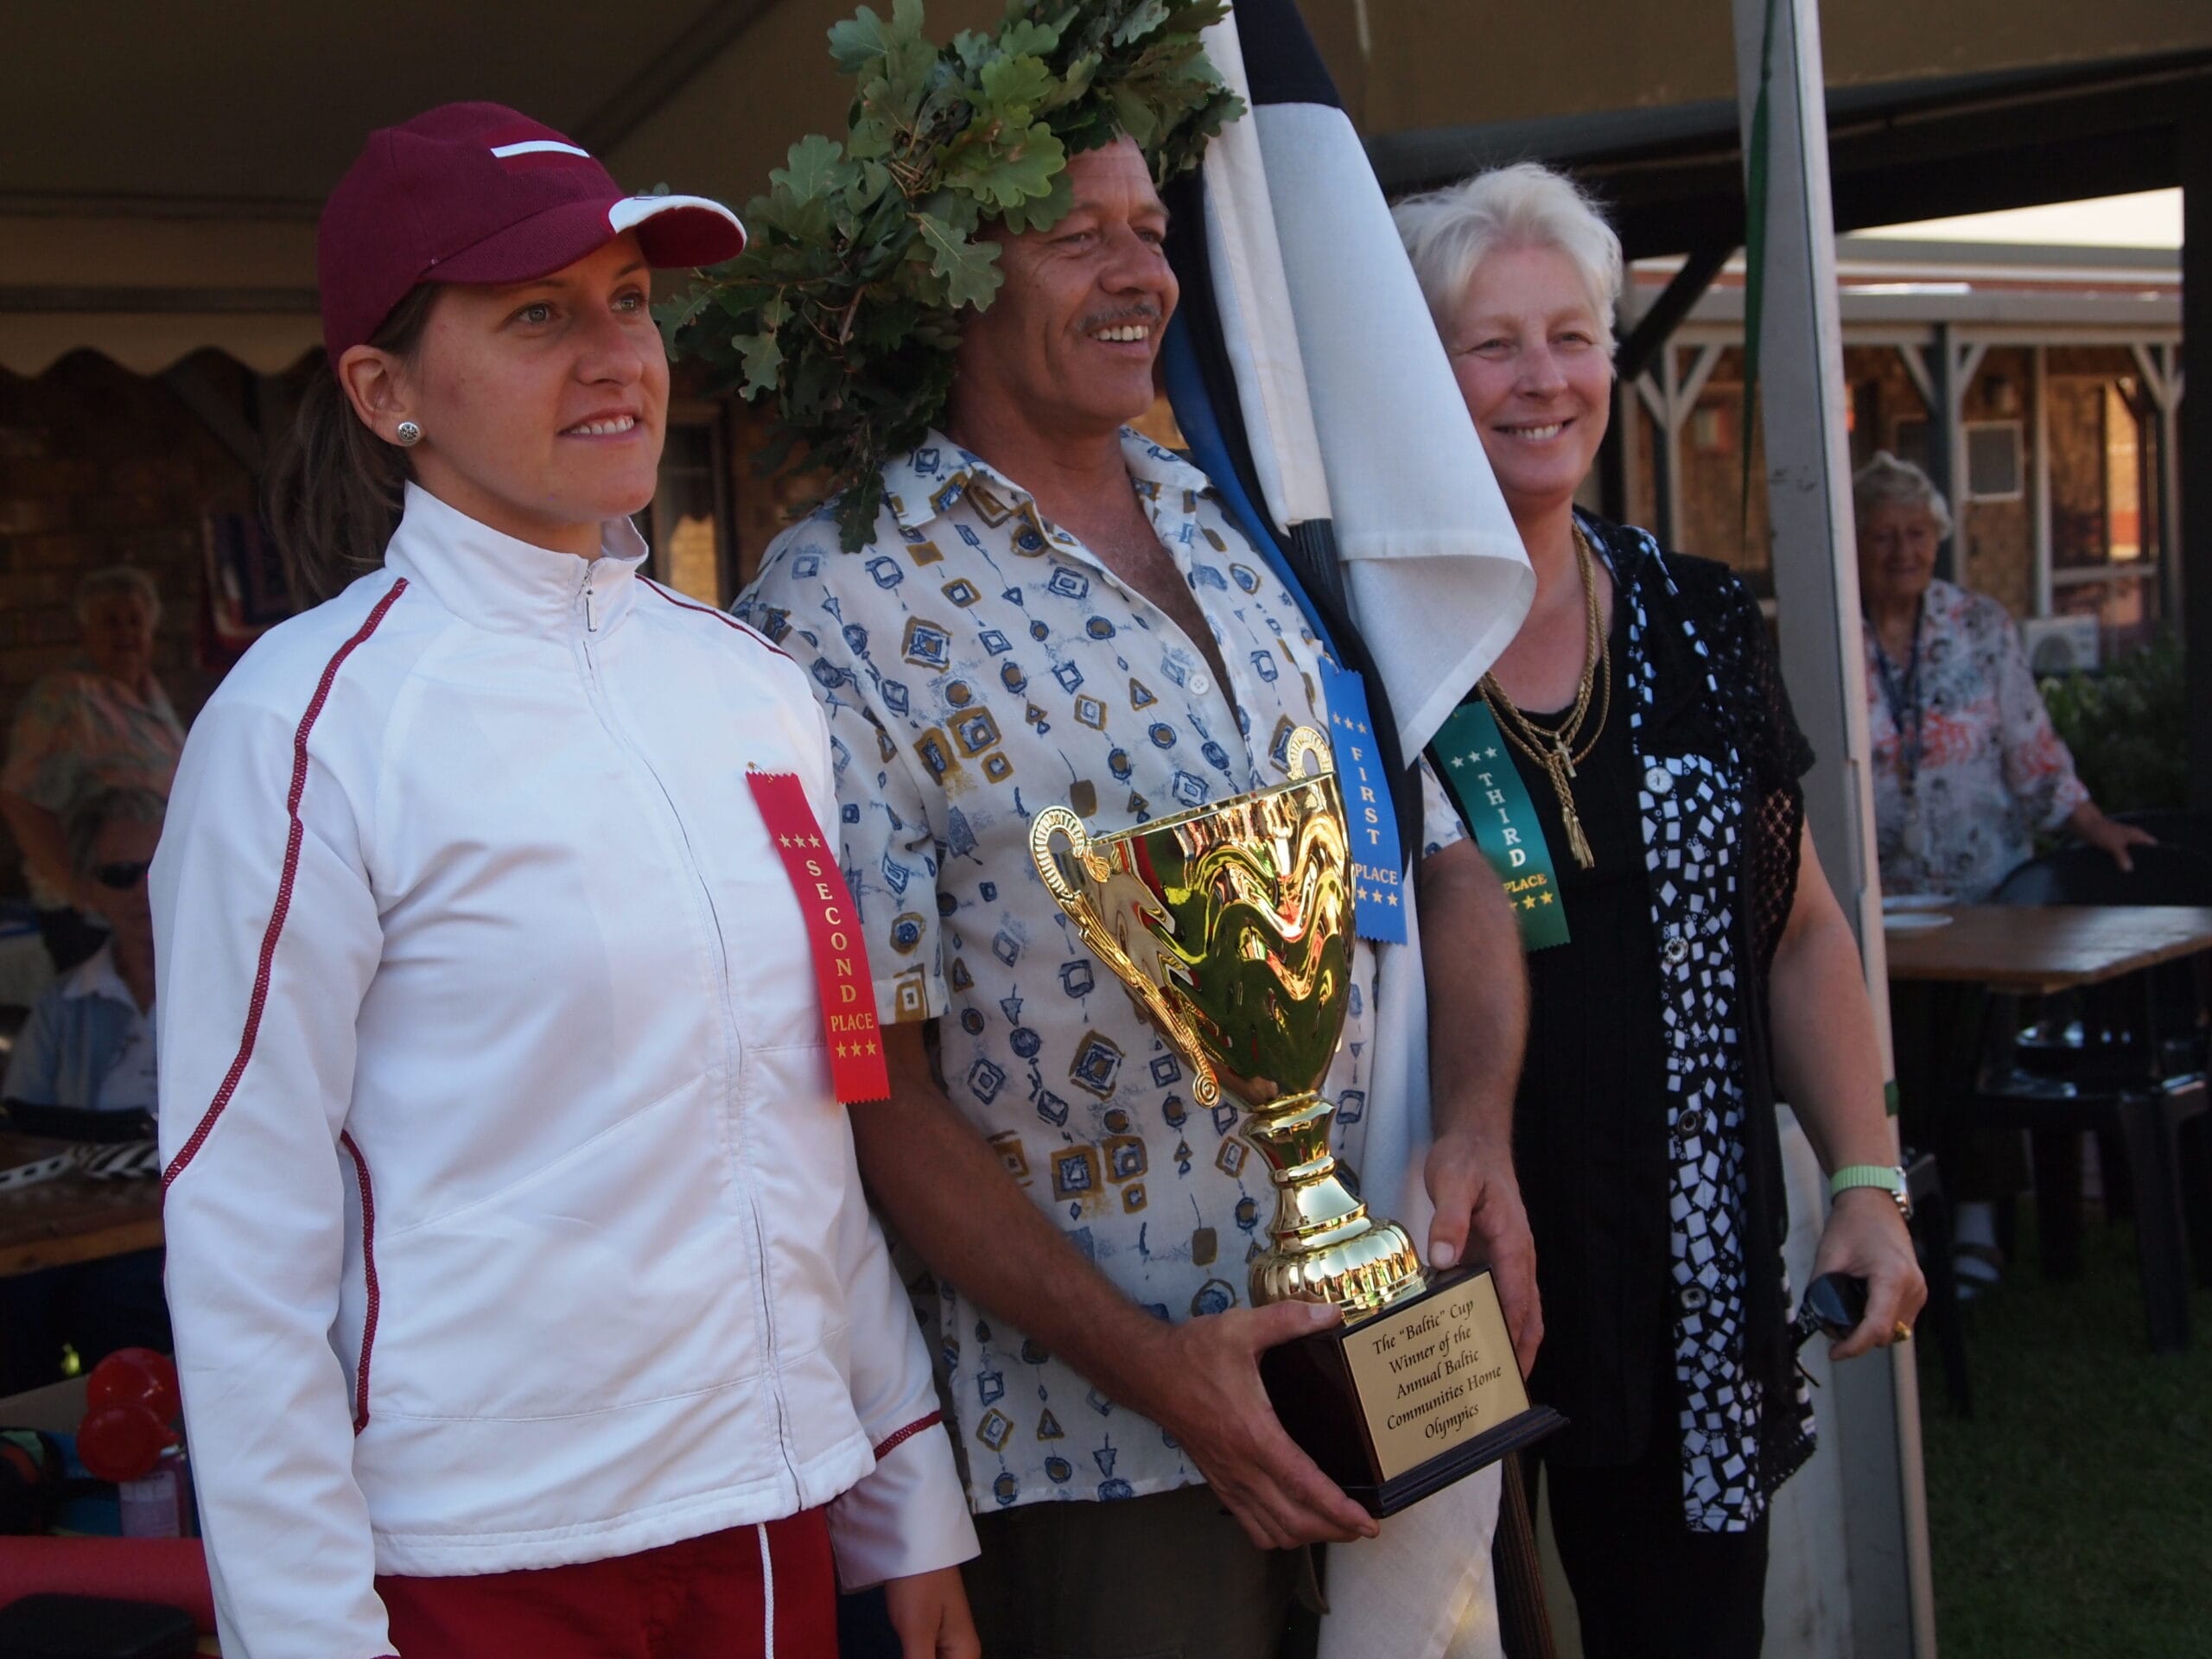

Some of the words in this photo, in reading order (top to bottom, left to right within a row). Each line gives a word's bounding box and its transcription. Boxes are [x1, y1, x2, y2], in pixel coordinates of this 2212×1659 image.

[1351, 747, 1380, 845] FIRST
[1478, 772, 1526, 867] THIRD
[1355, 864, 1398, 885] PLACE
[1503, 874, 1547, 893] PLACE
[805, 860, 857, 1003] SECOND
[831, 1014, 874, 1032] PLACE
[1372, 1334, 1396, 1355] The
[1450, 1300, 1474, 1320] Cup
[1389, 1345, 1435, 1374] Winner
[1440, 1332, 1452, 1357] of
[1454, 1325, 1471, 1344] the
[1387, 1383, 1464, 1430] Communities
[1467, 1366, 1502, 1391] Home
[1396, 1362, 1441, 1399] Annual
[1445, 1350, 1479, 1375] Baltic
[1426, 1404, 1479, 1440] Olympics
